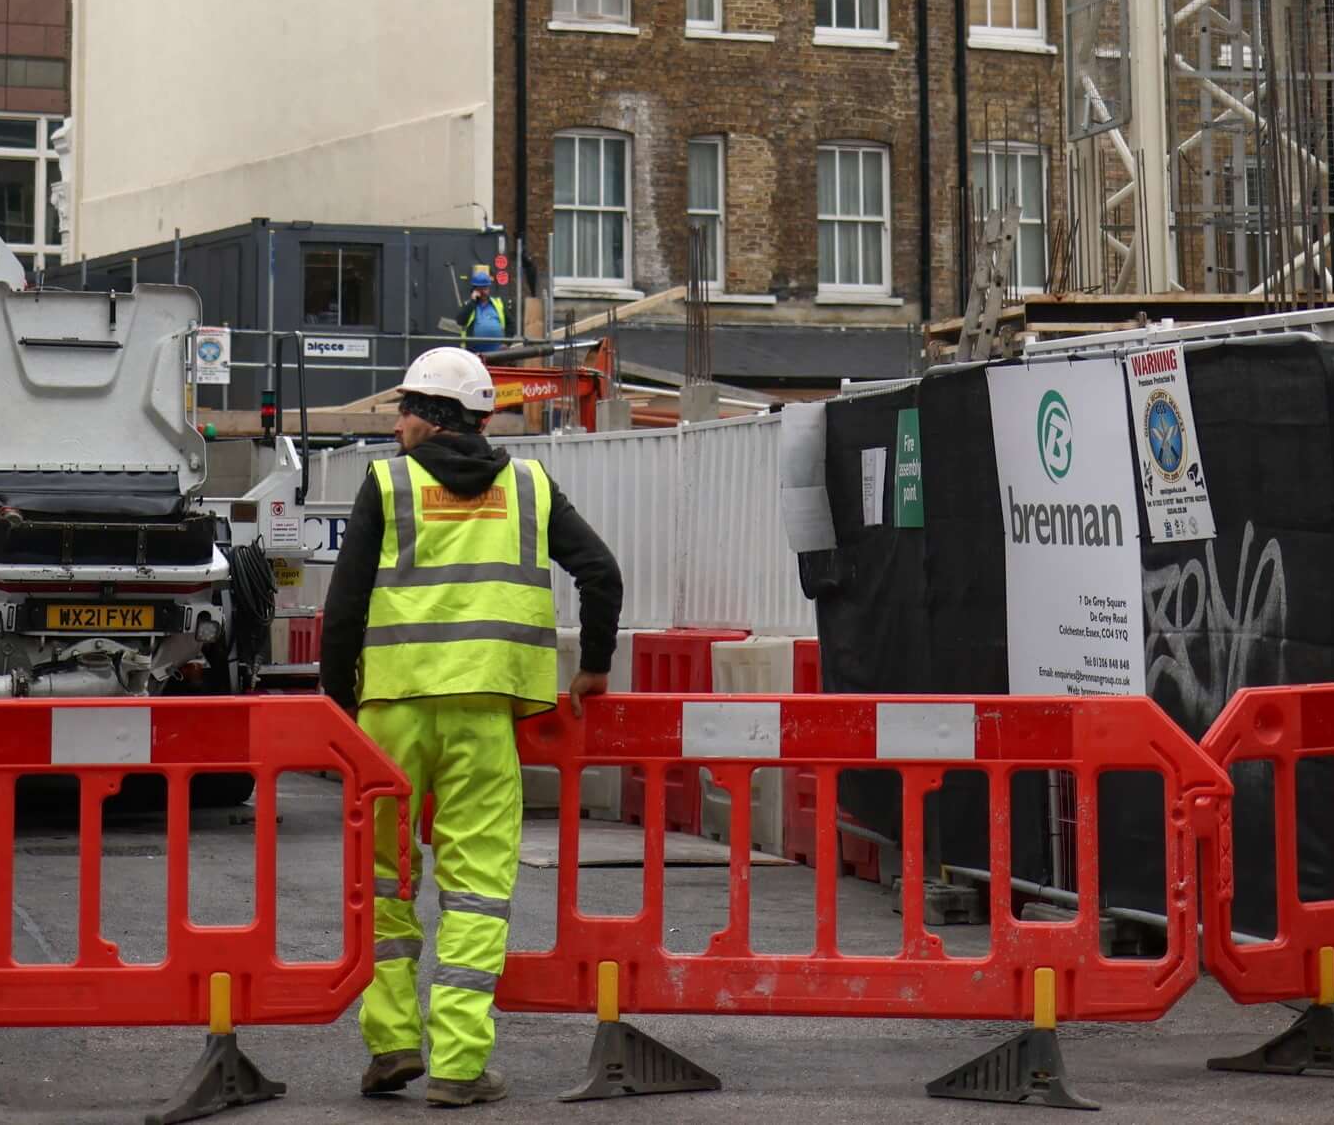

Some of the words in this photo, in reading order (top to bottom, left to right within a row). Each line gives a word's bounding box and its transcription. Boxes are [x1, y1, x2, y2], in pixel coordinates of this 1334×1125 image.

[1131, 349, 1178, 377] WARNING
[903, 435, 915, 452] Fire
[898, 459, 922, 482] assembly
[903, 483, 917, 507] point
[1007, 485, 1124, 547] brennan
[1084, 595, 1092, 606] De
[1093, 596, 1105, 609] Grey
[1107, 597, 1127, 610] Square
[59, 608, 101, 626] WX21
[106, 609, 143, 626] FYK
[1090, 611, 1098, 622] De
[1099, 612, 1112, 625] Grey
[1113, 613, 1128, 624] Road
[1101, 628, 1114, 638] CO4
[1115, 629, 1129, 642] 5YQ
